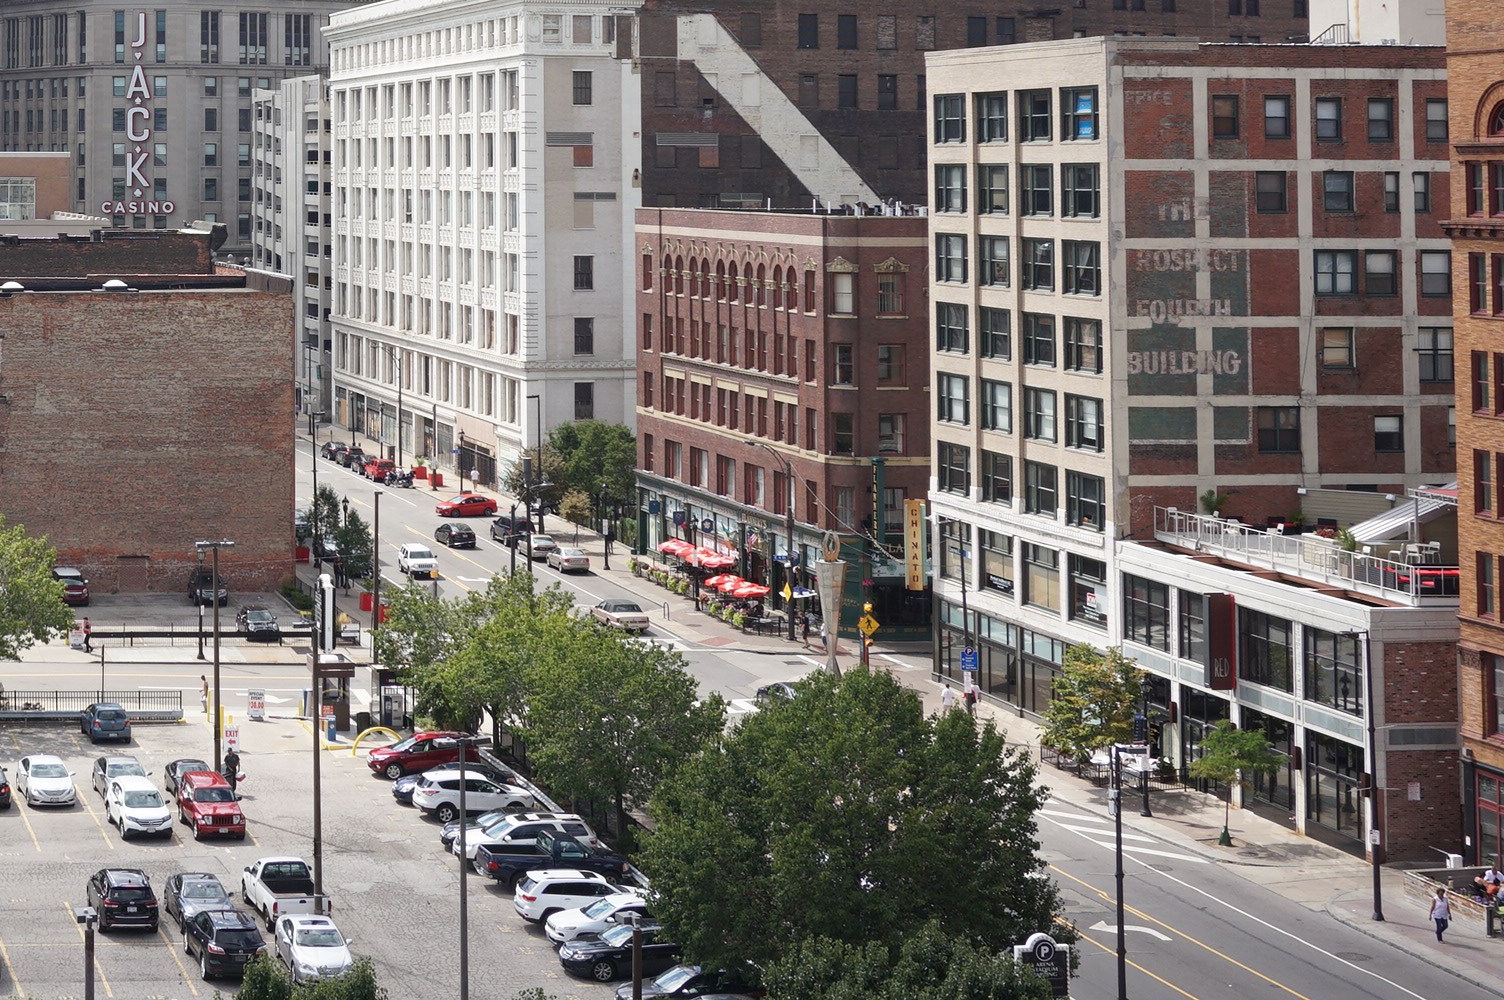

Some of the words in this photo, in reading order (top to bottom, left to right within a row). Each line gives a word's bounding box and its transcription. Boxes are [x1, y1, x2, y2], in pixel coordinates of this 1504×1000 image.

[125, 11, 151, 188] JACK
[101, 200, 176, 214] CASINO
[1127, 350, 1242, 375] BUILDING
[910, 508, 919, 583] CHINATO
[1214, 657, 1230, 678] RED
[225, 730, 238, 738] EXIT
[1041, 946, 1049, 957] P
